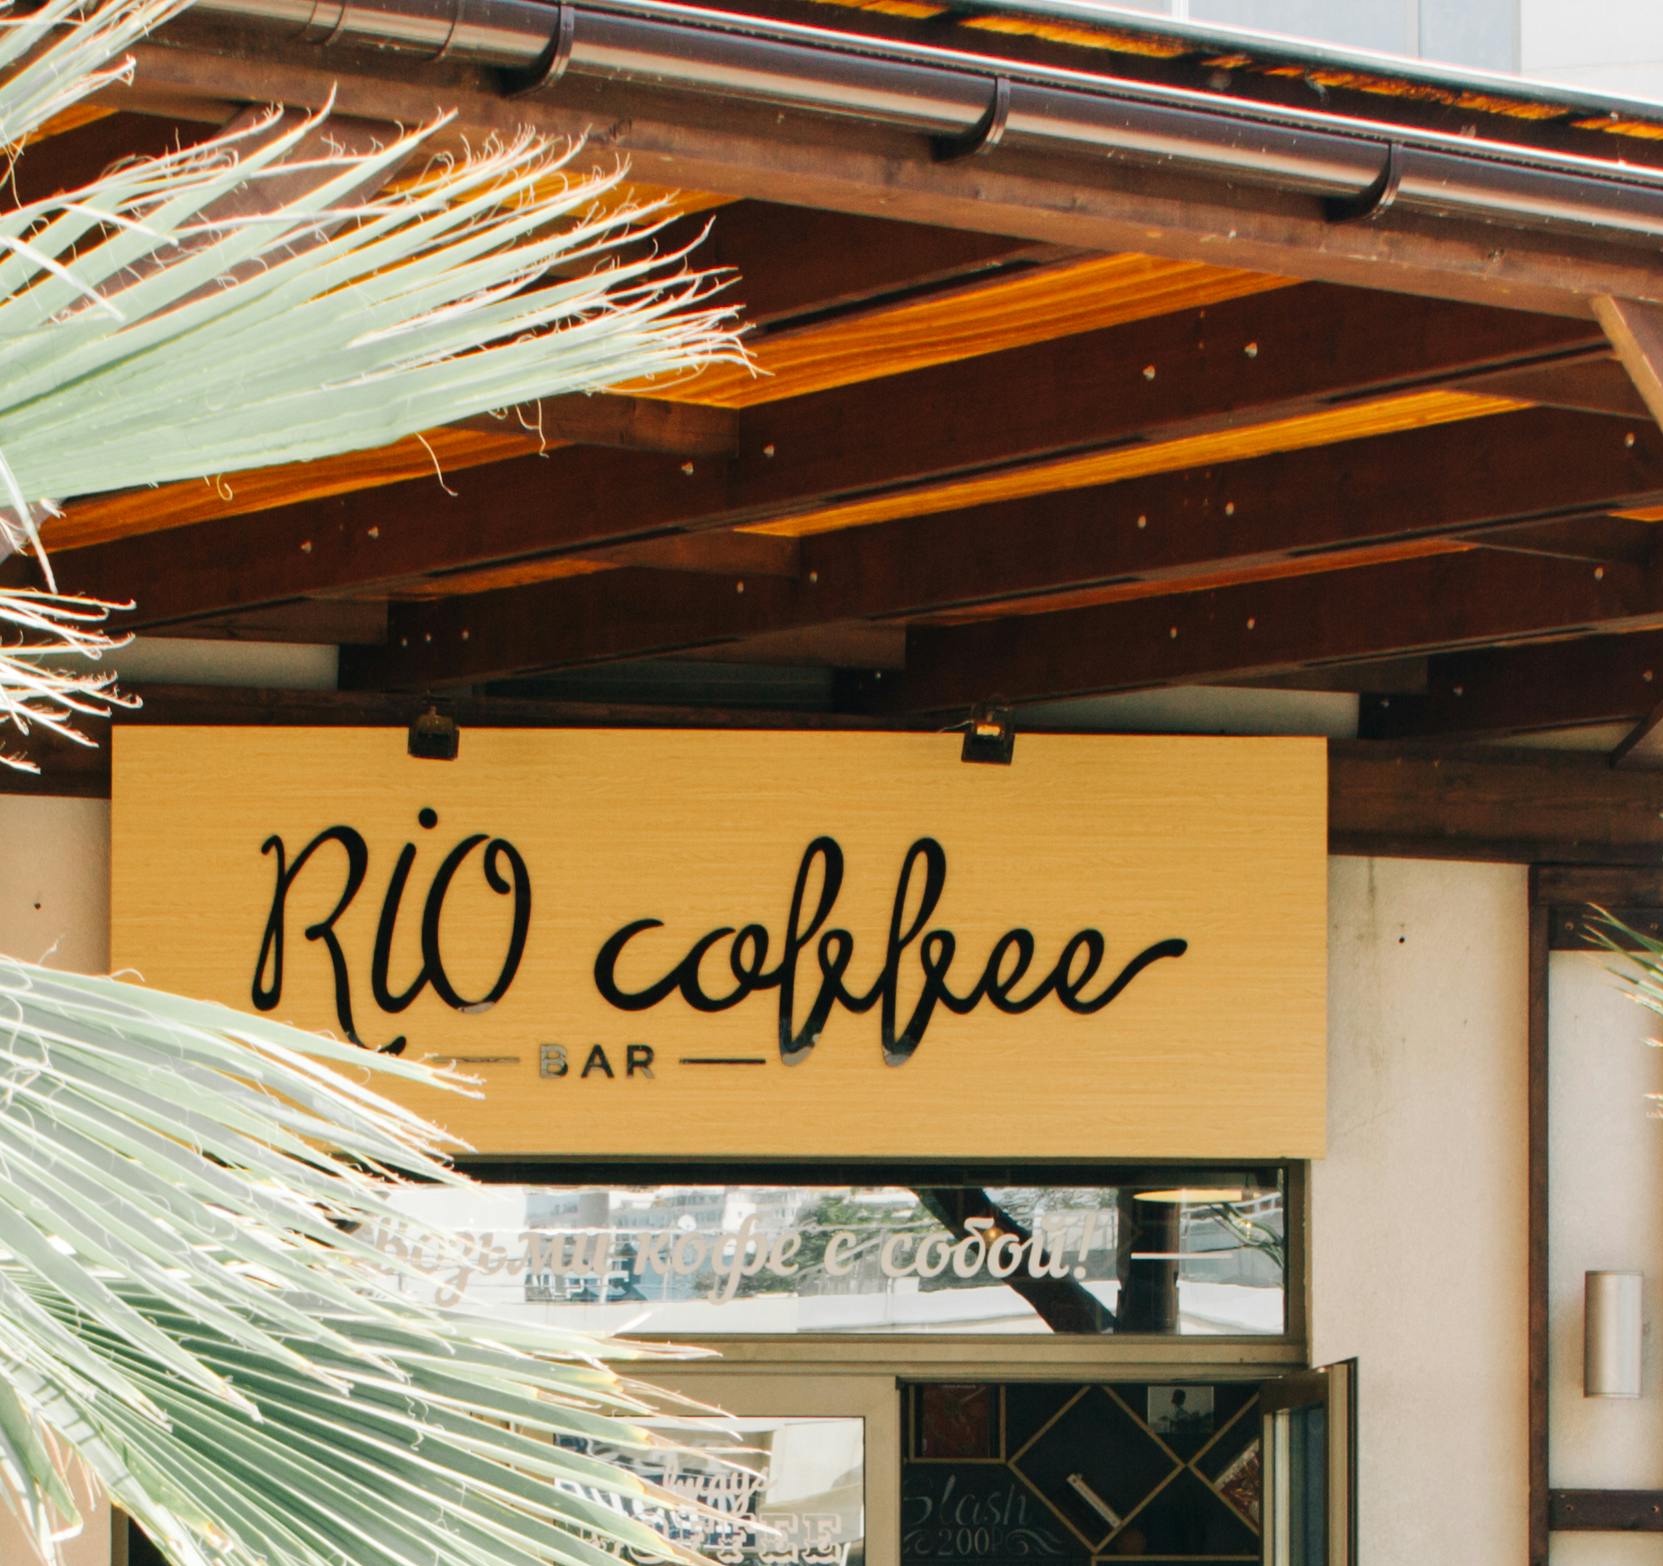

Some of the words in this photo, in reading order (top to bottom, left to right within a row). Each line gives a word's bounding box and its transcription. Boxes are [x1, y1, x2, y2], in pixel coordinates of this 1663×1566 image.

[594, 837, 1188, 1067] coffee
[539, 1043, 657, 1080] BAR
[634, 1211, 799, 1307] кофе
[824, 1228, 858, 1276] с
[880, 1213, 1097, 1279] собой!
